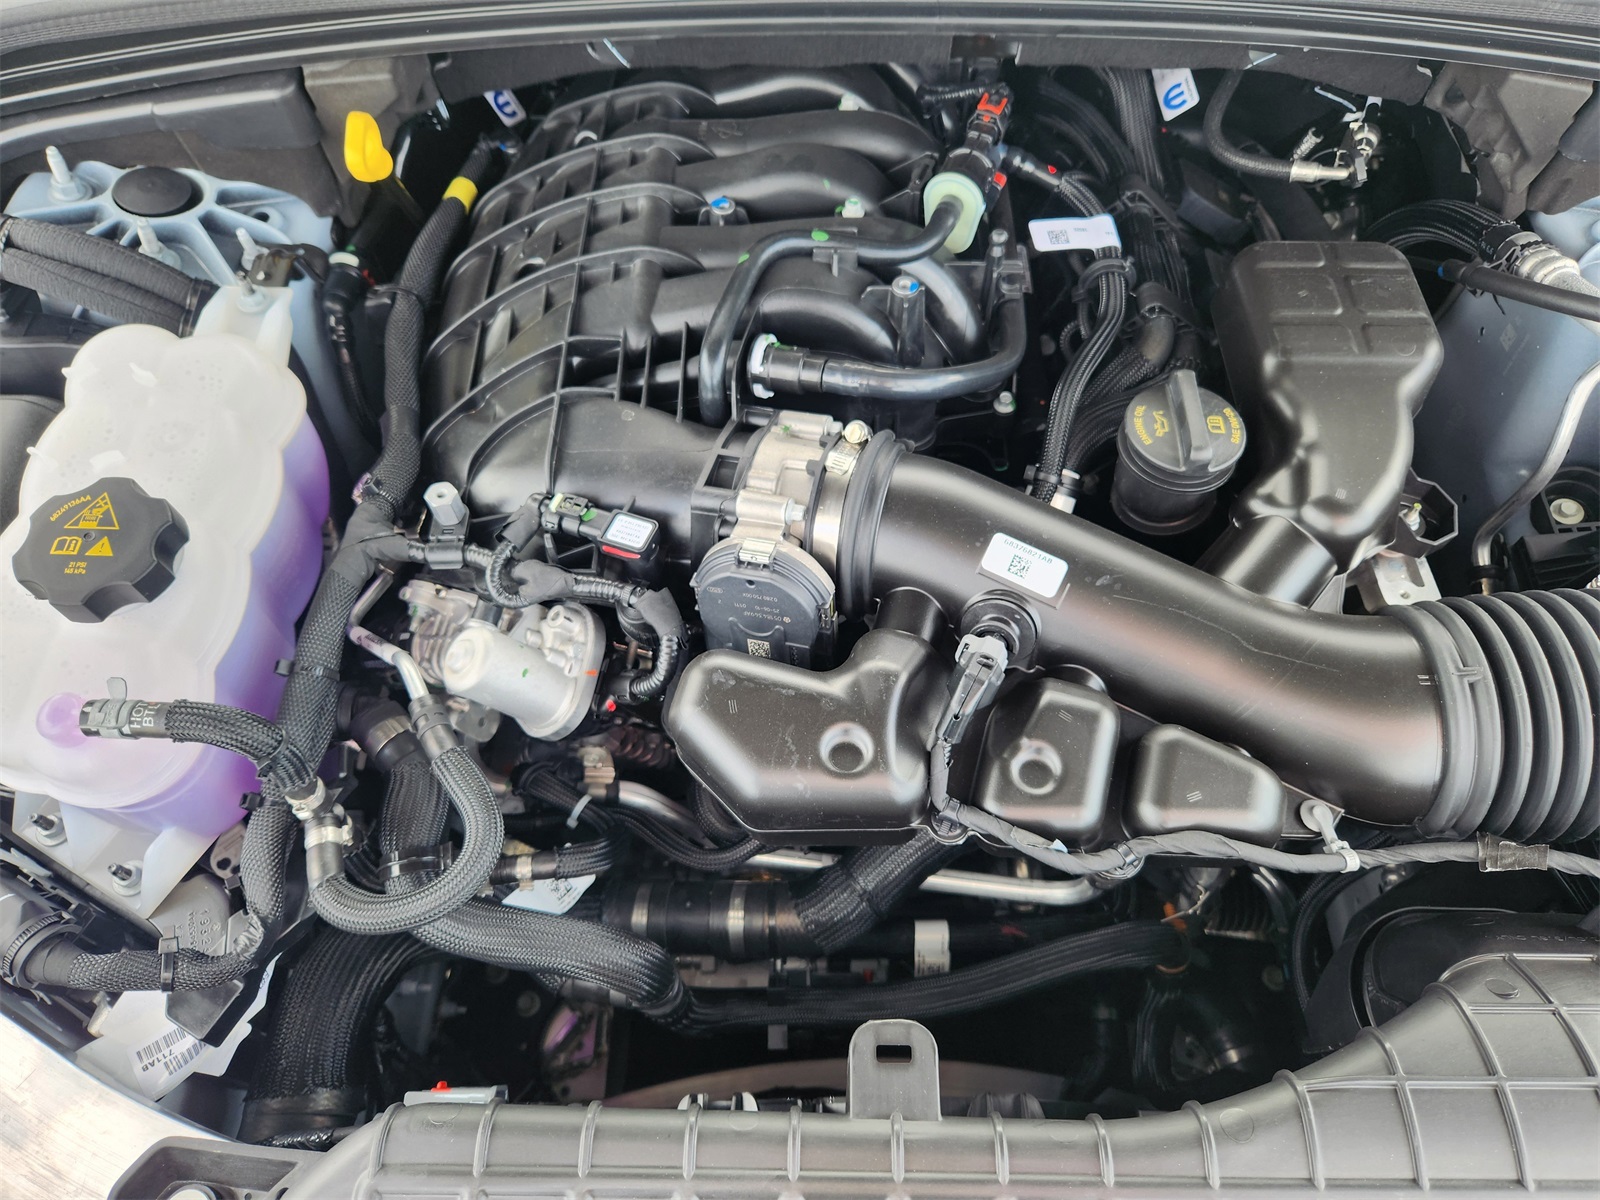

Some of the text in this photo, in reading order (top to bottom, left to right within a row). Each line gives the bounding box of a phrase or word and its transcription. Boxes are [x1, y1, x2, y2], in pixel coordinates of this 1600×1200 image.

[1134, 405, 1152, 445] ENGINE OIL
[1231, 427, 1241, 444] SAE
[141, 1049, 175, 1072] 711AB
